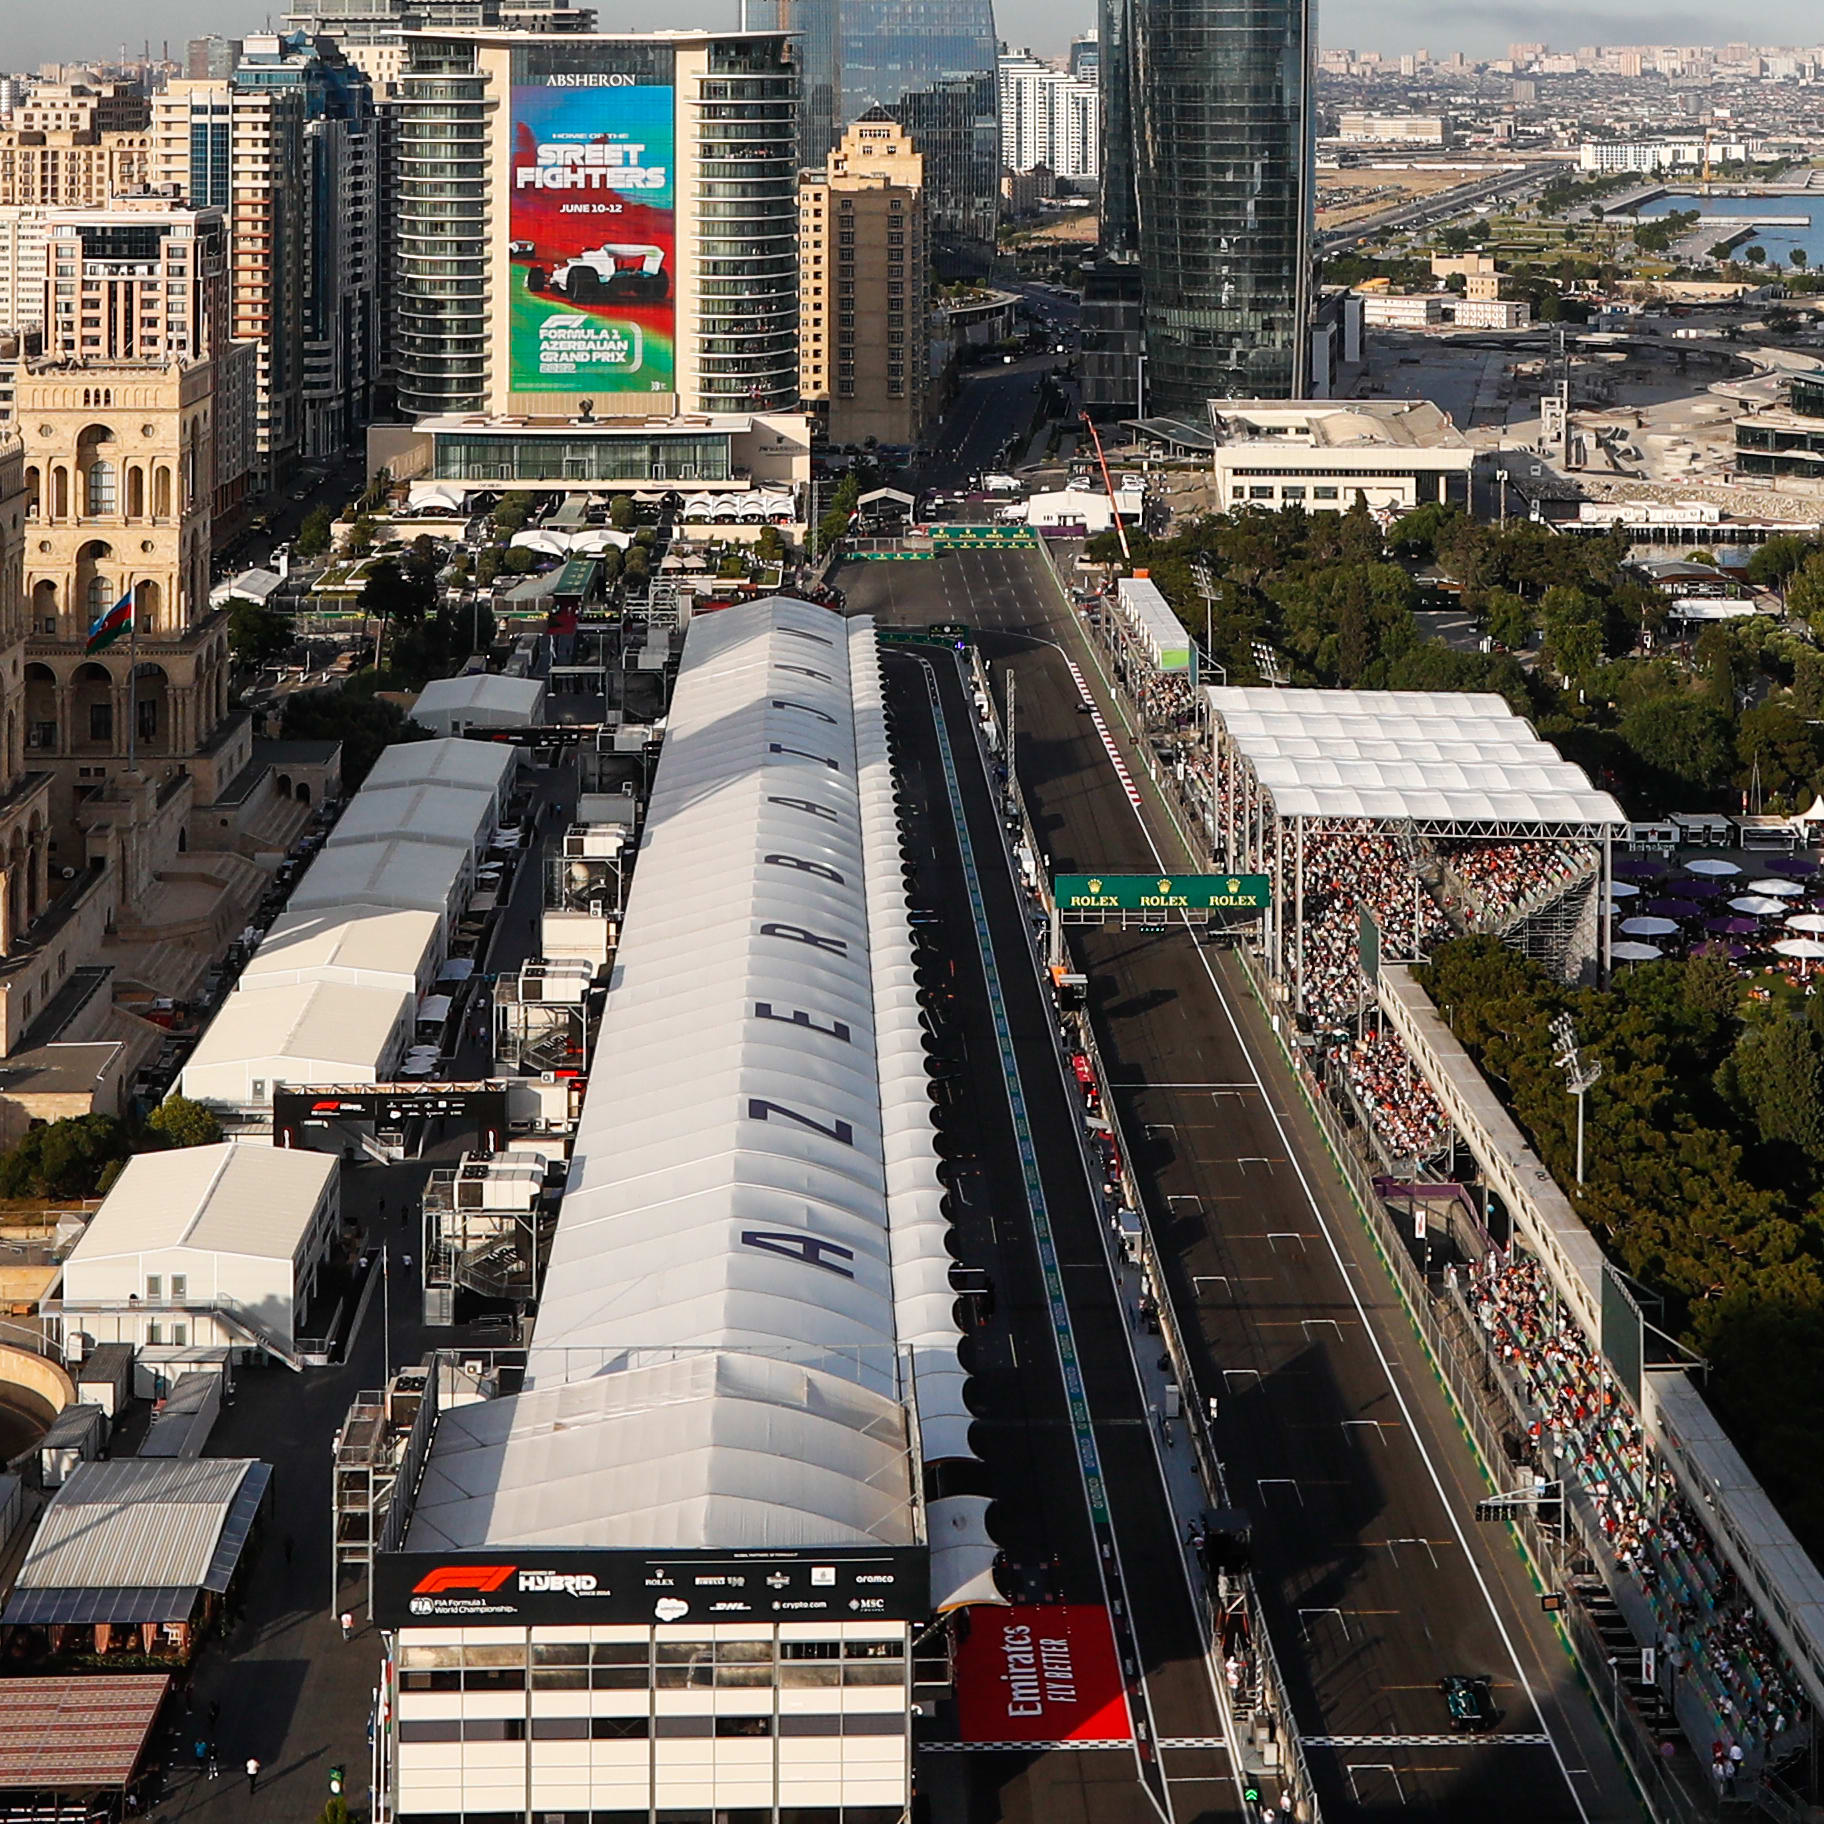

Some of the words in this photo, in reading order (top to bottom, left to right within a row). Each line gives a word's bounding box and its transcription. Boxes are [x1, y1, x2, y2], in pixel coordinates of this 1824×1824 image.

[546, 74, 636, 87] ABSHERON
[537, 143, 645, 166] STREET
[516, 167, 666, 189] FIGHTERS
[560, 204, 589, 213] JUNE
[591, 204, 623, 213] 10-12
[540, 329, 610, 340] FORMULA
[612, 329, 620, 340] 1
[540, 341, 628, 351] AZERBAIJAN
[540, 352, 591, 362] GRAND
[592, 352, 626, 362] PRIX
[1629, 843, 1675, 852] Heineken
[1071, 896, 1118, 906] ROLEX
[1140, 896, 1188, 906] ROLEX
[1210, 896, 1256, 906] ROLEX
[739, 626, 854, 1280] AZERBAIJAN
[519, 1575, 597, 1597] HYBRID
[410, 1598, 434, 1615] FIA
[860, 1599, 884, 1608] MSC
[1040, 1638, 1073, 1679] BETTER
[1000, 1625, 1043, 1717] Emirates
[1046, 1682, 1077, 1702] FLY
